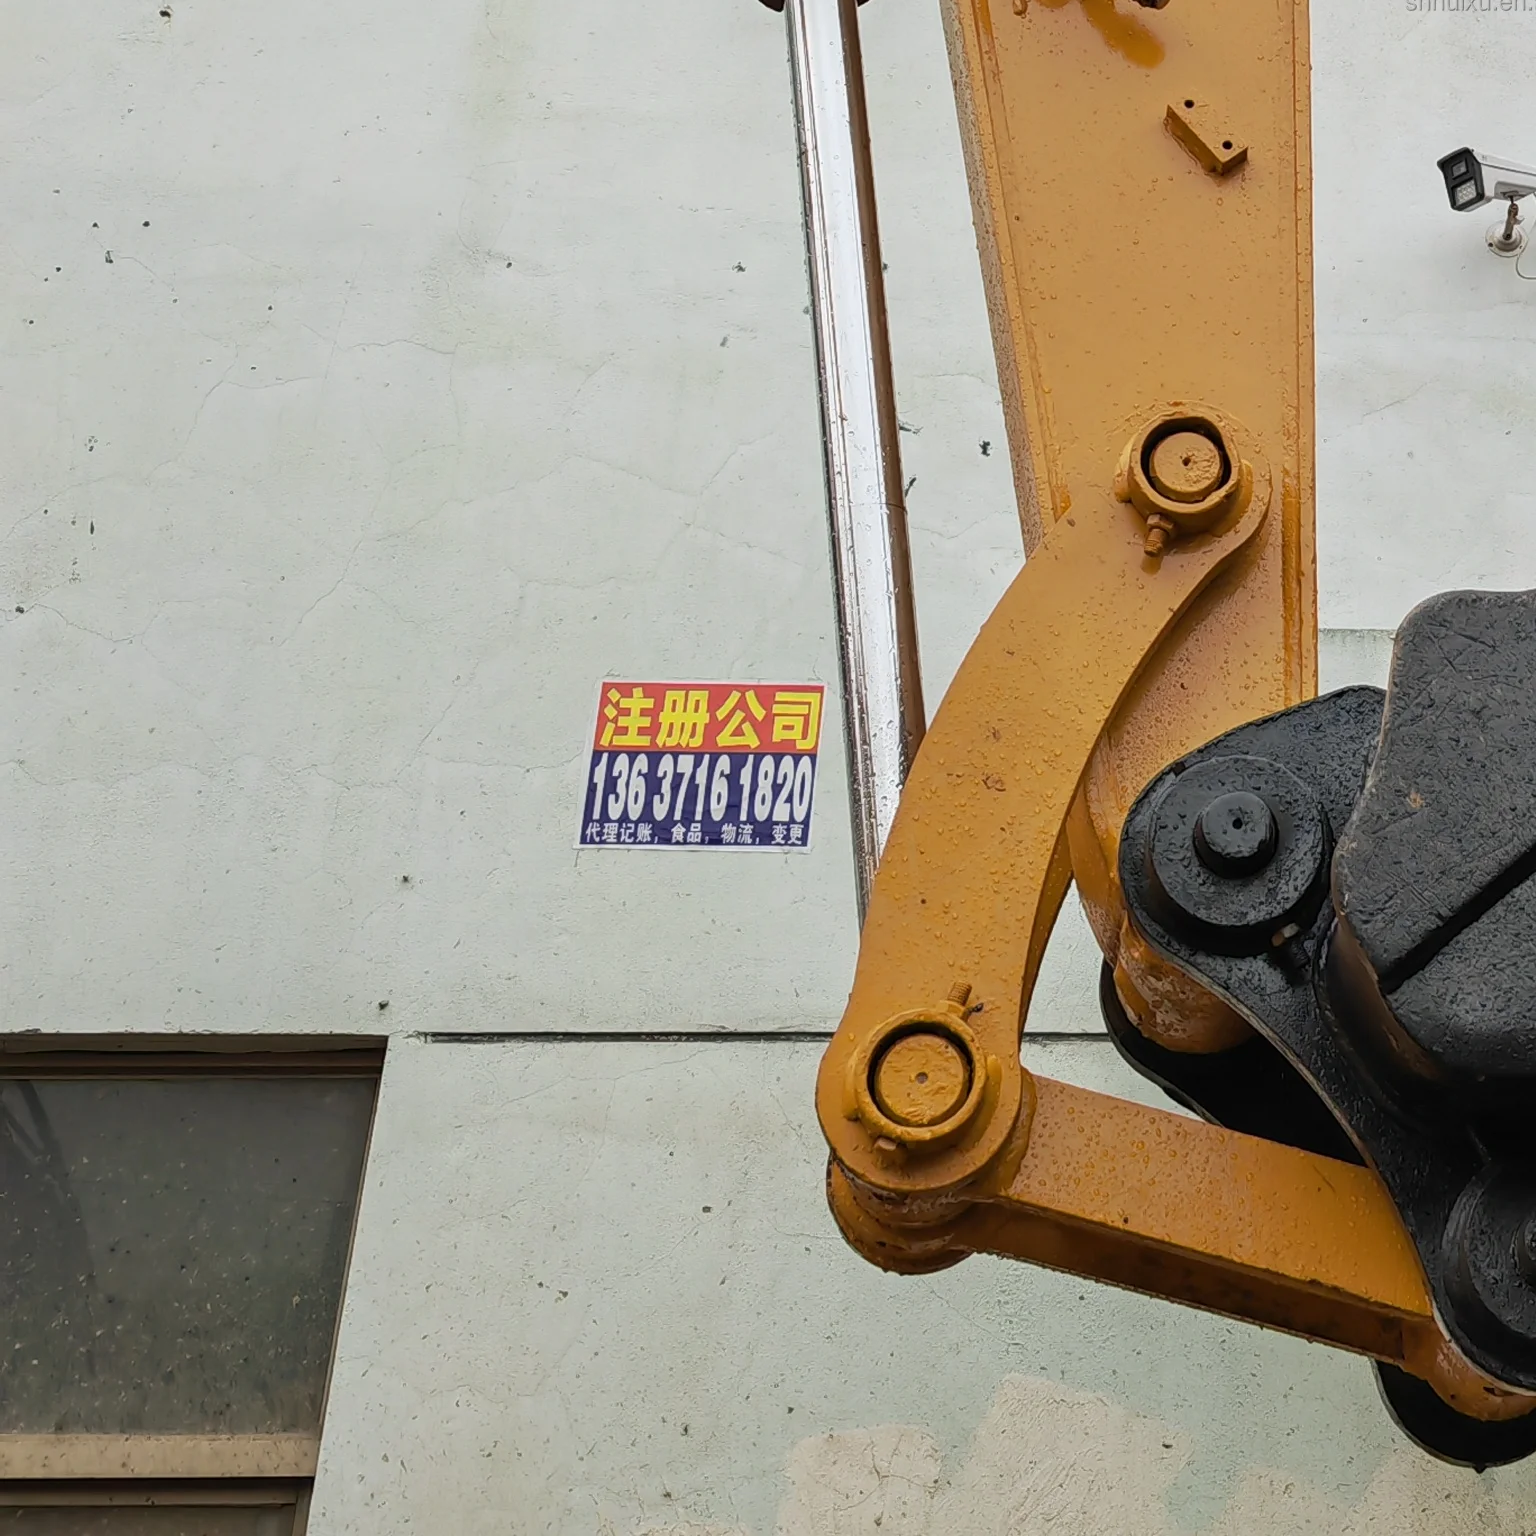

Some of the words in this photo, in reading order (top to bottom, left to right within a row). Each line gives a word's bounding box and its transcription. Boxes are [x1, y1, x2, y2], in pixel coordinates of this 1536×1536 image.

[599, 686, 822, 750] 注册公司
[592, 751, 649, 822] 136
[652, 752, 731, 822] 3716
[739, 753, 813, 823] 1820
